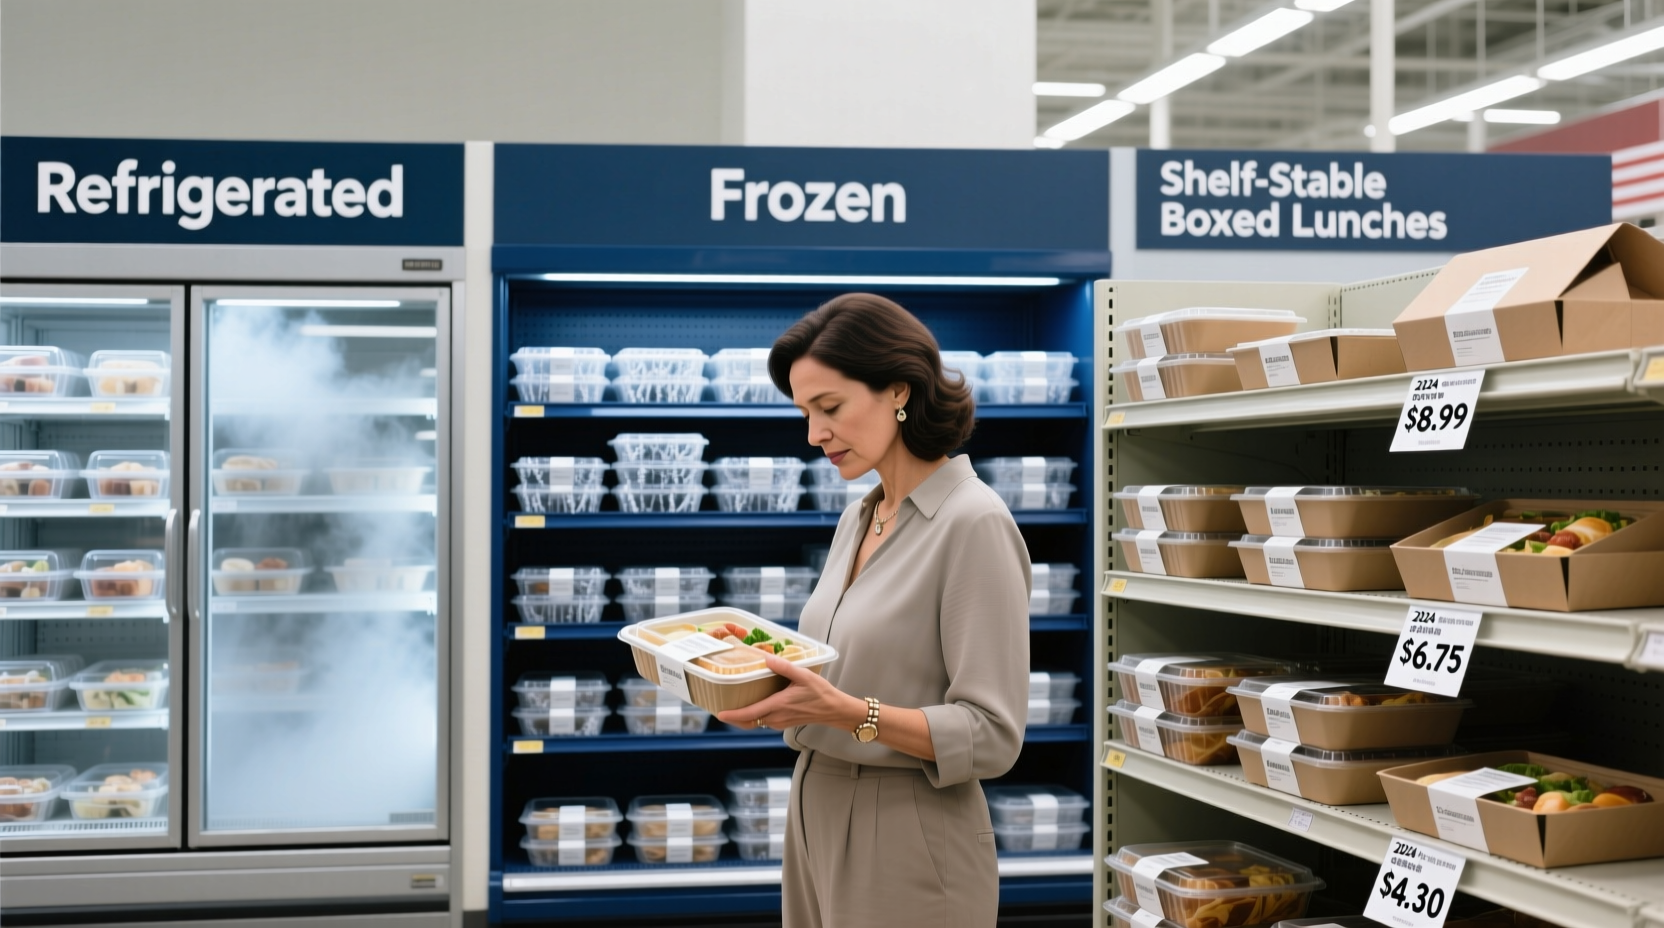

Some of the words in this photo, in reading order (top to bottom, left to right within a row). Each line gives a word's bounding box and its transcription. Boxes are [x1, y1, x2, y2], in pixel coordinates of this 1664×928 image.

[37, 158, 404, 231] Refrigerated
[710, 167, 907, 223] Frozen
[1160, 159, 1387, 200] Shelf-Stable
[1160, 201, 1280, 238] Boxed
[1292, 202, 1448, 240] Lunches
[1404, 402, 1468, 433] $8.99
[1399, 637, 1465, 674] $6.75
[1379, 868, 1445, 919] $4.30
